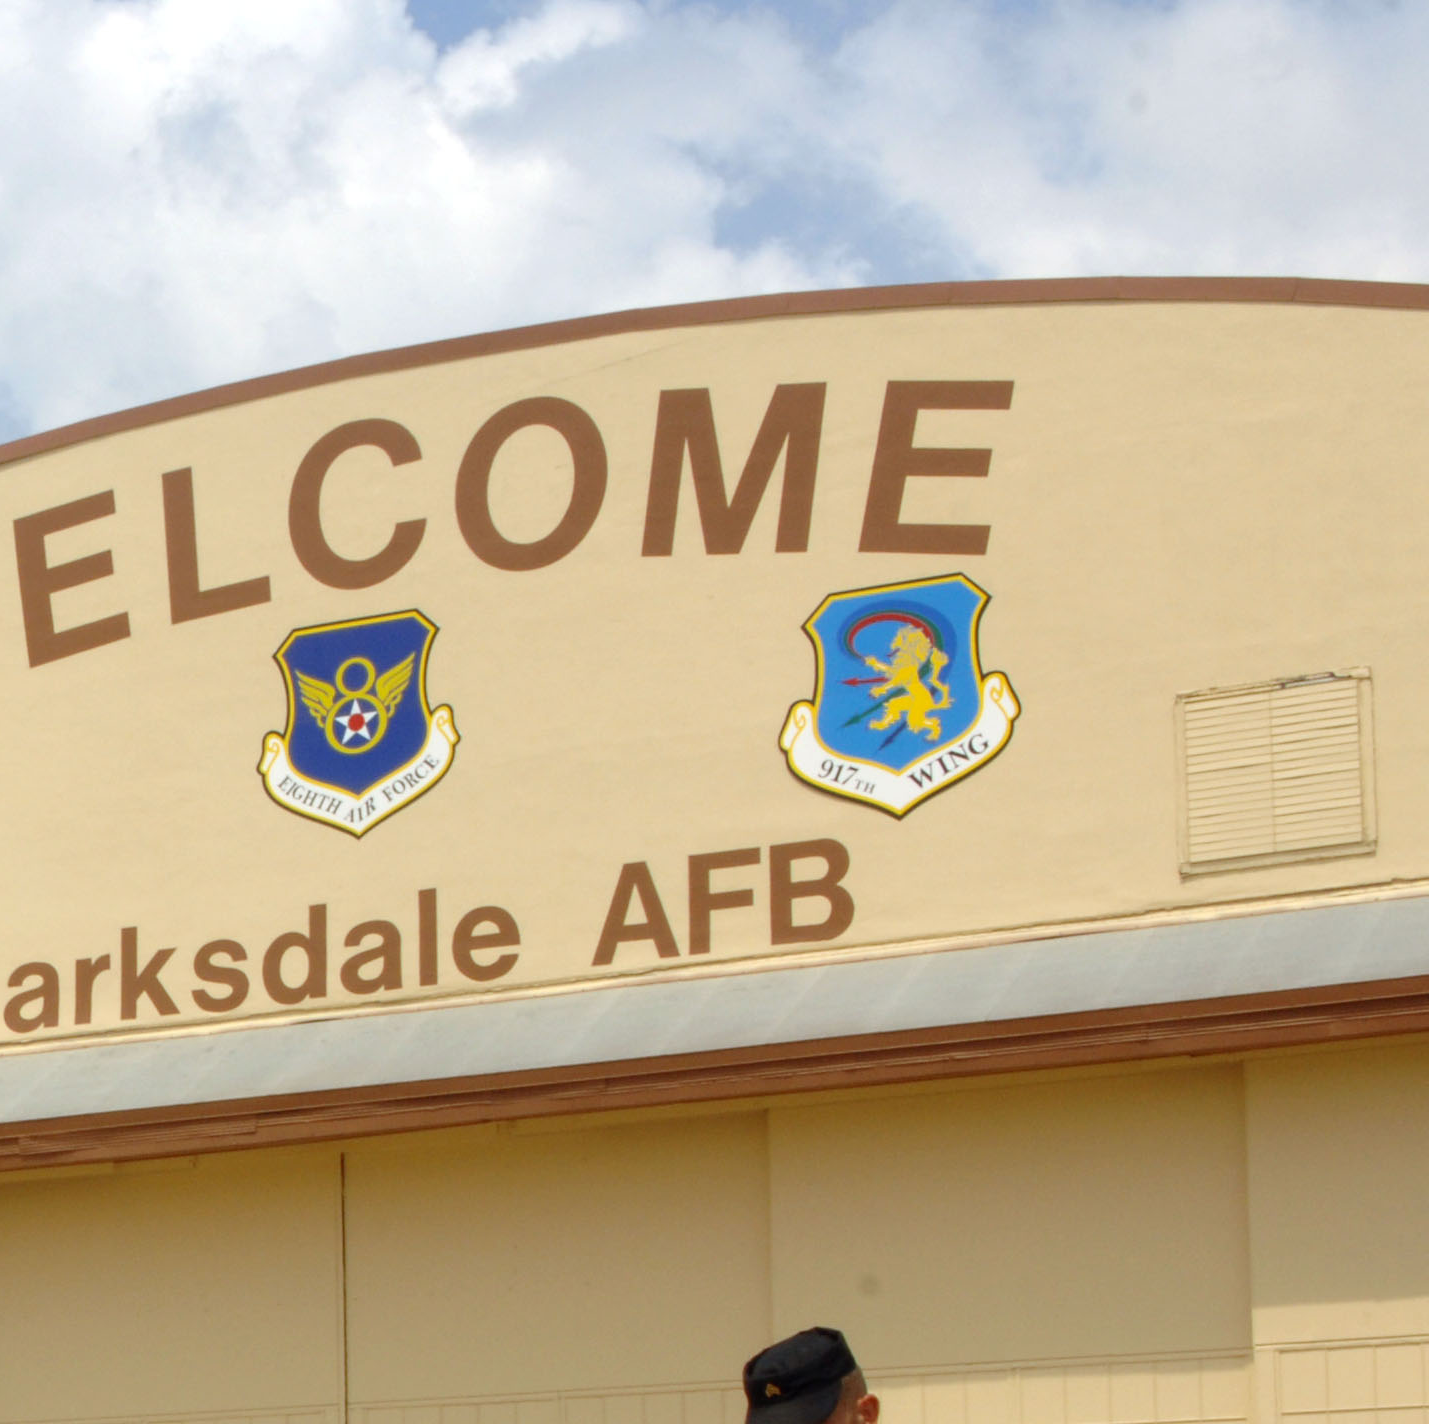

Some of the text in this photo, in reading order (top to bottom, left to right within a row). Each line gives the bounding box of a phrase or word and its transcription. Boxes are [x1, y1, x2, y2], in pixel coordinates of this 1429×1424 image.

[277, 754, 439, 823] EIGHTH AIR FORCE
[907, 733, 989, 789] WING
[591, 837, 855, 967] AFB
